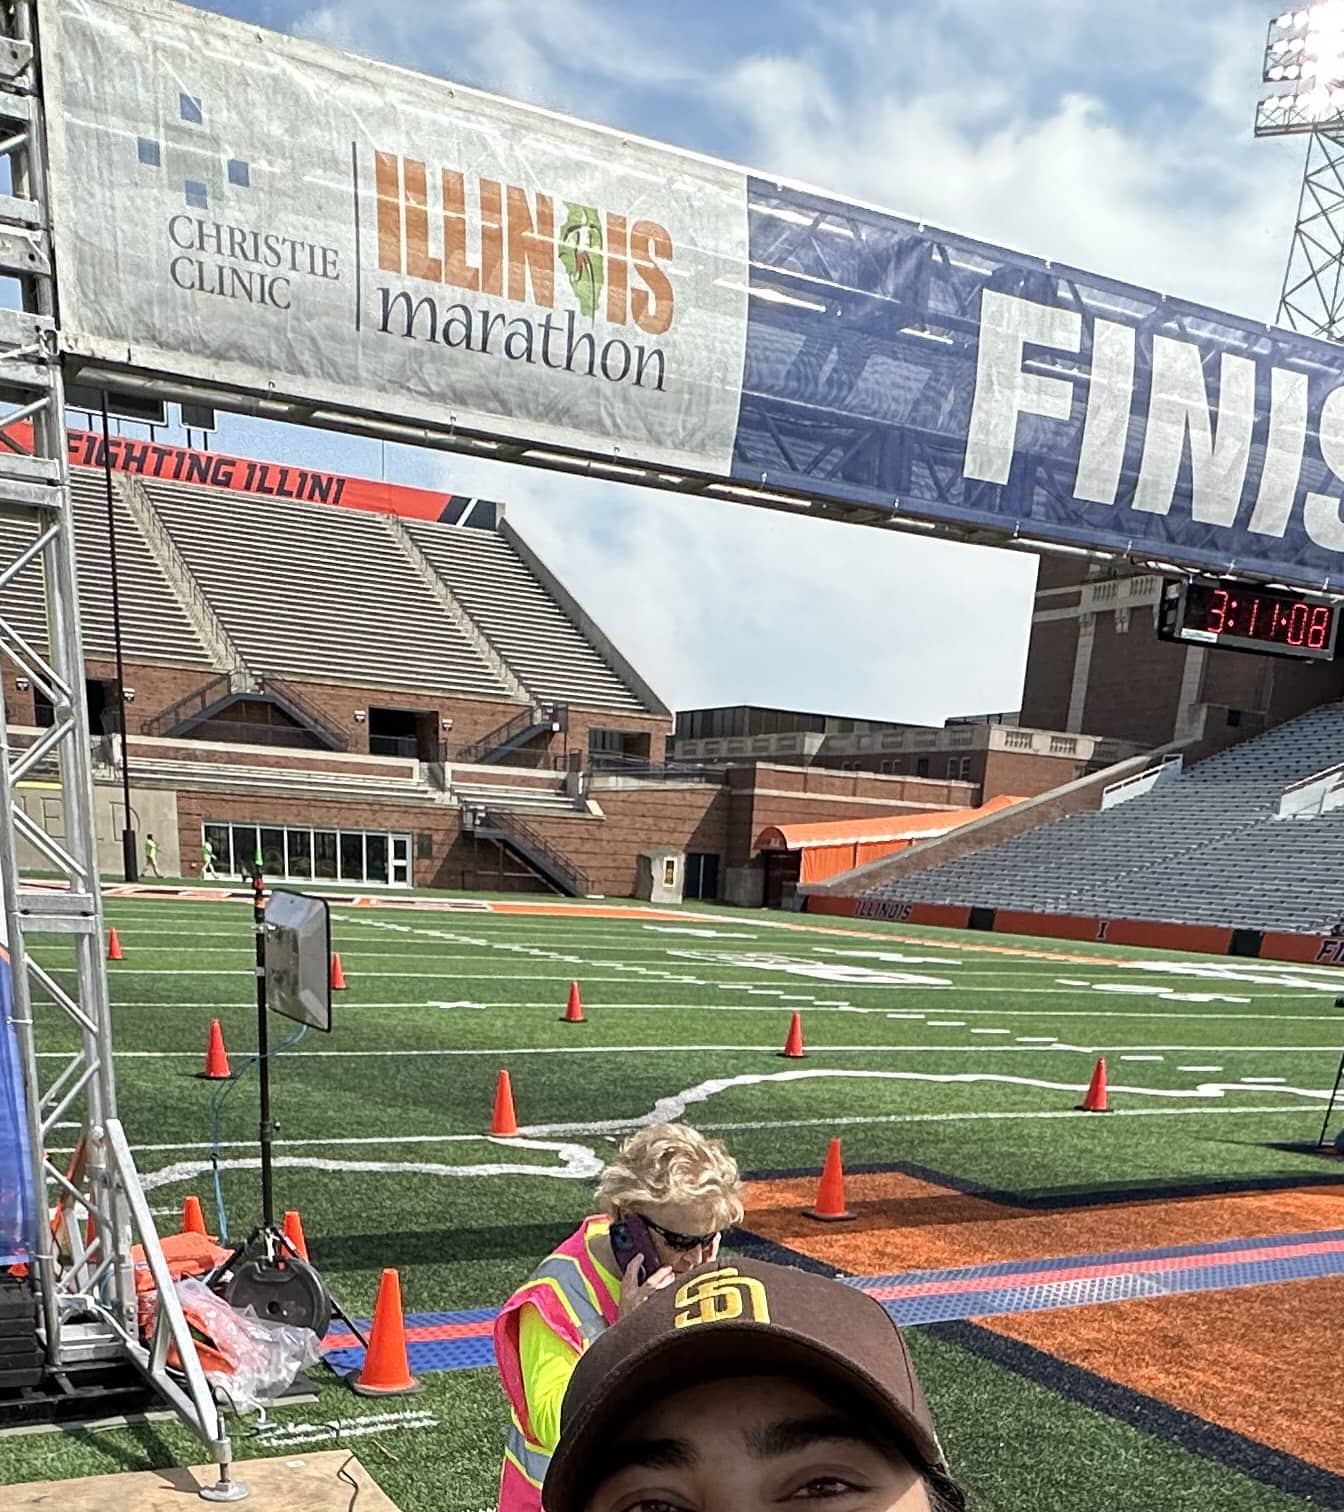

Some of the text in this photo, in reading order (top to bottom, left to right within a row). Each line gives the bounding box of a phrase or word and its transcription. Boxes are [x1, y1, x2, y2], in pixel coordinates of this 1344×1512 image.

[168, 214, 341, 281] CHRISTIE
[170, 256, 293, 310] CLINIC
[377, 286, 667, 392] marathon
[67, 432, 346, 505] FIGHTING ILLINI
[855, 899, 913, 921] ILLINOIS
